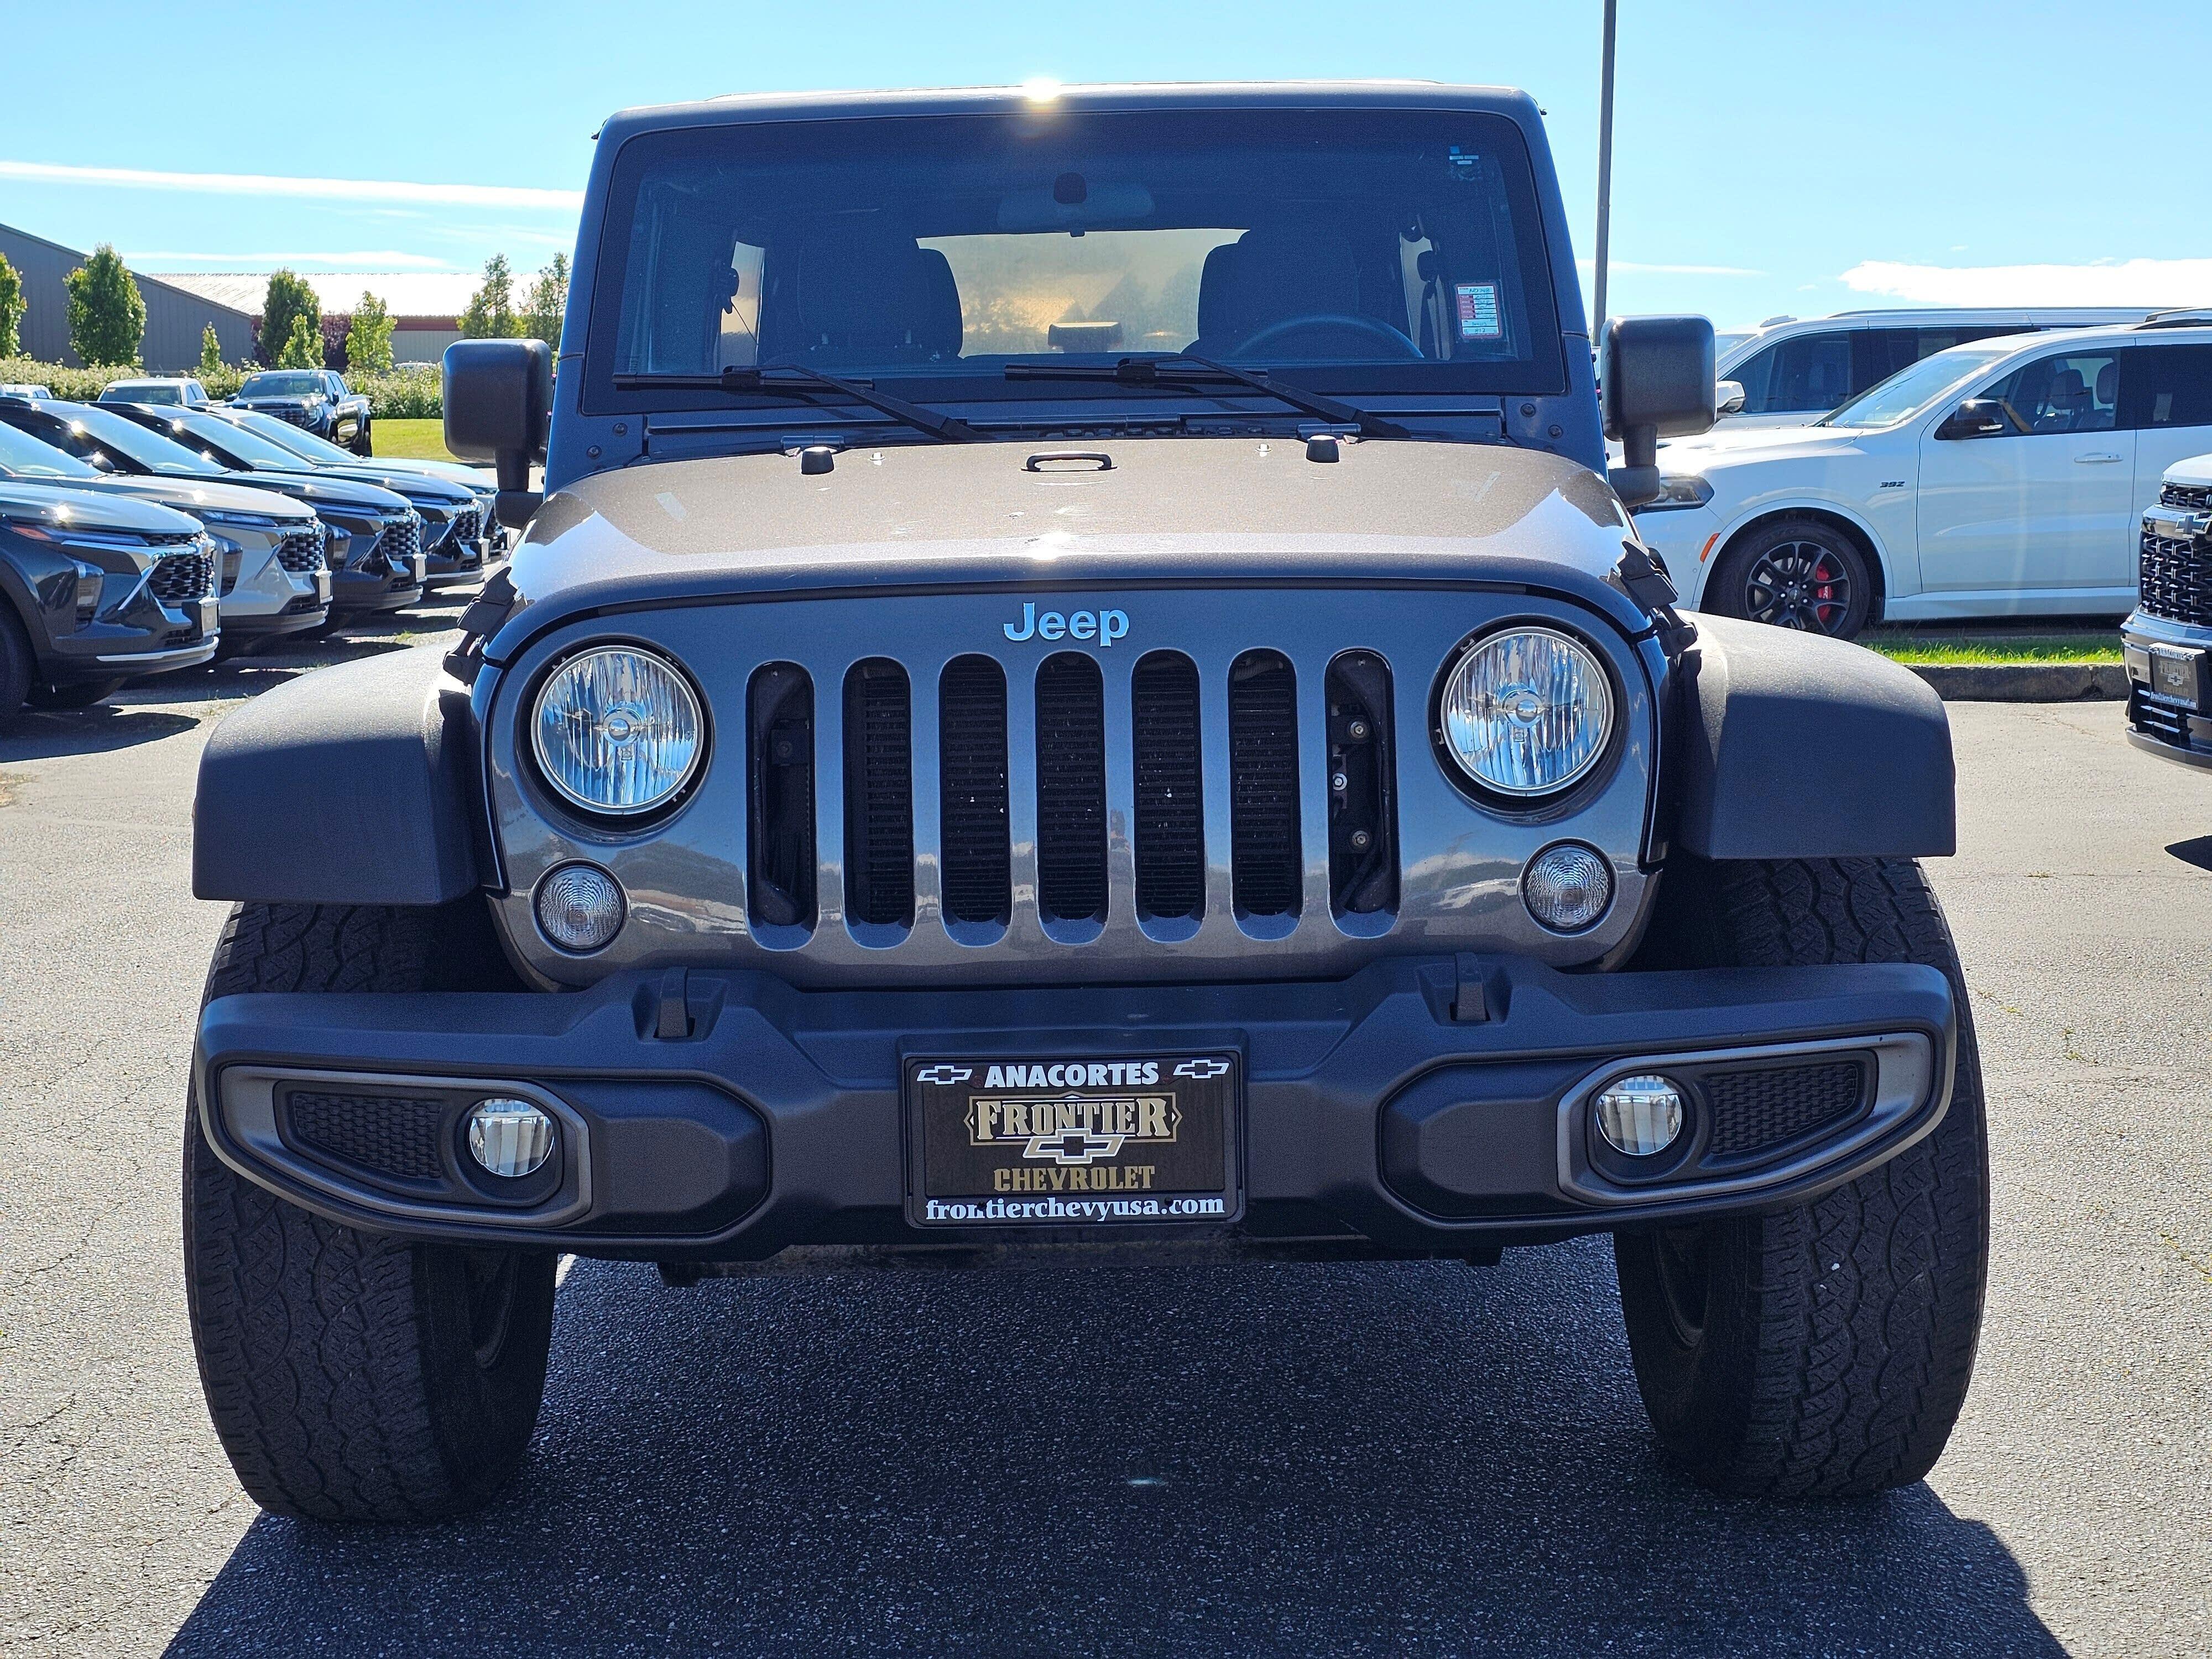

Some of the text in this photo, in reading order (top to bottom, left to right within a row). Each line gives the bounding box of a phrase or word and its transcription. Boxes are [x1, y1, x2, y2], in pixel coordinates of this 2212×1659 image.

[1003, 602, 1129, 647] Jeep
[984, 1062, 1159, 1088] ANACORTES
[975, 1097, 1171, 1140] FRONTIER
[994, 1165, 1155, 1192] CHEVROLET
[926, 1197, 1225, 1222] frontierchevyusa.com
